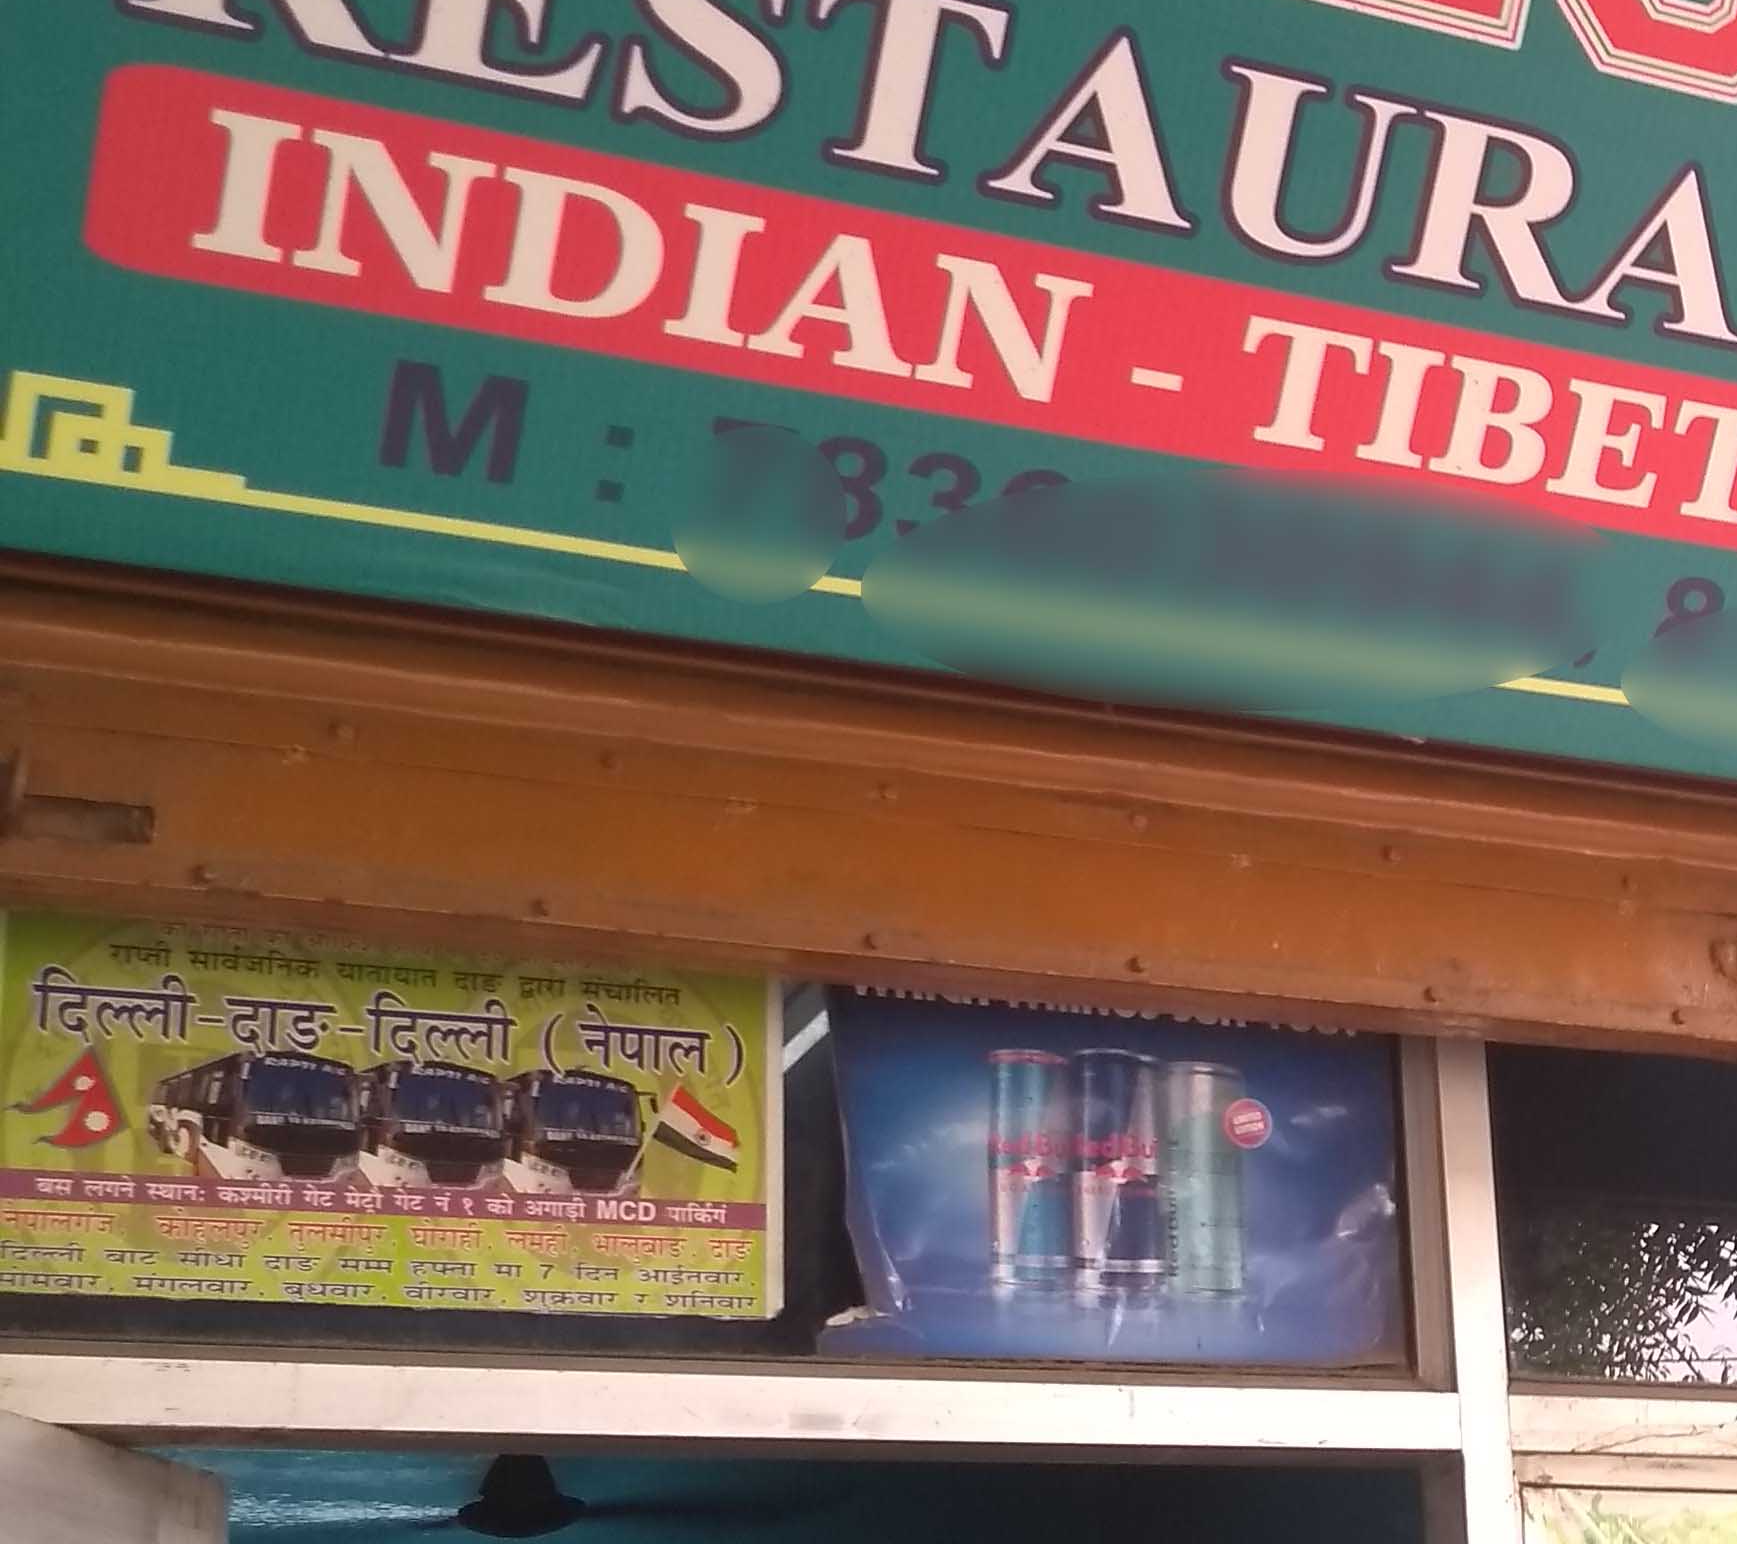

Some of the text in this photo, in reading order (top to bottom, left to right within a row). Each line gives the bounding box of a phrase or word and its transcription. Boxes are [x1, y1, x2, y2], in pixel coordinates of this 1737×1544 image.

[190, 107, 1094, 405] INDIAN
[596, 1199, 656, 1223] MCD
[540, 1264, 554, 1280] 7
